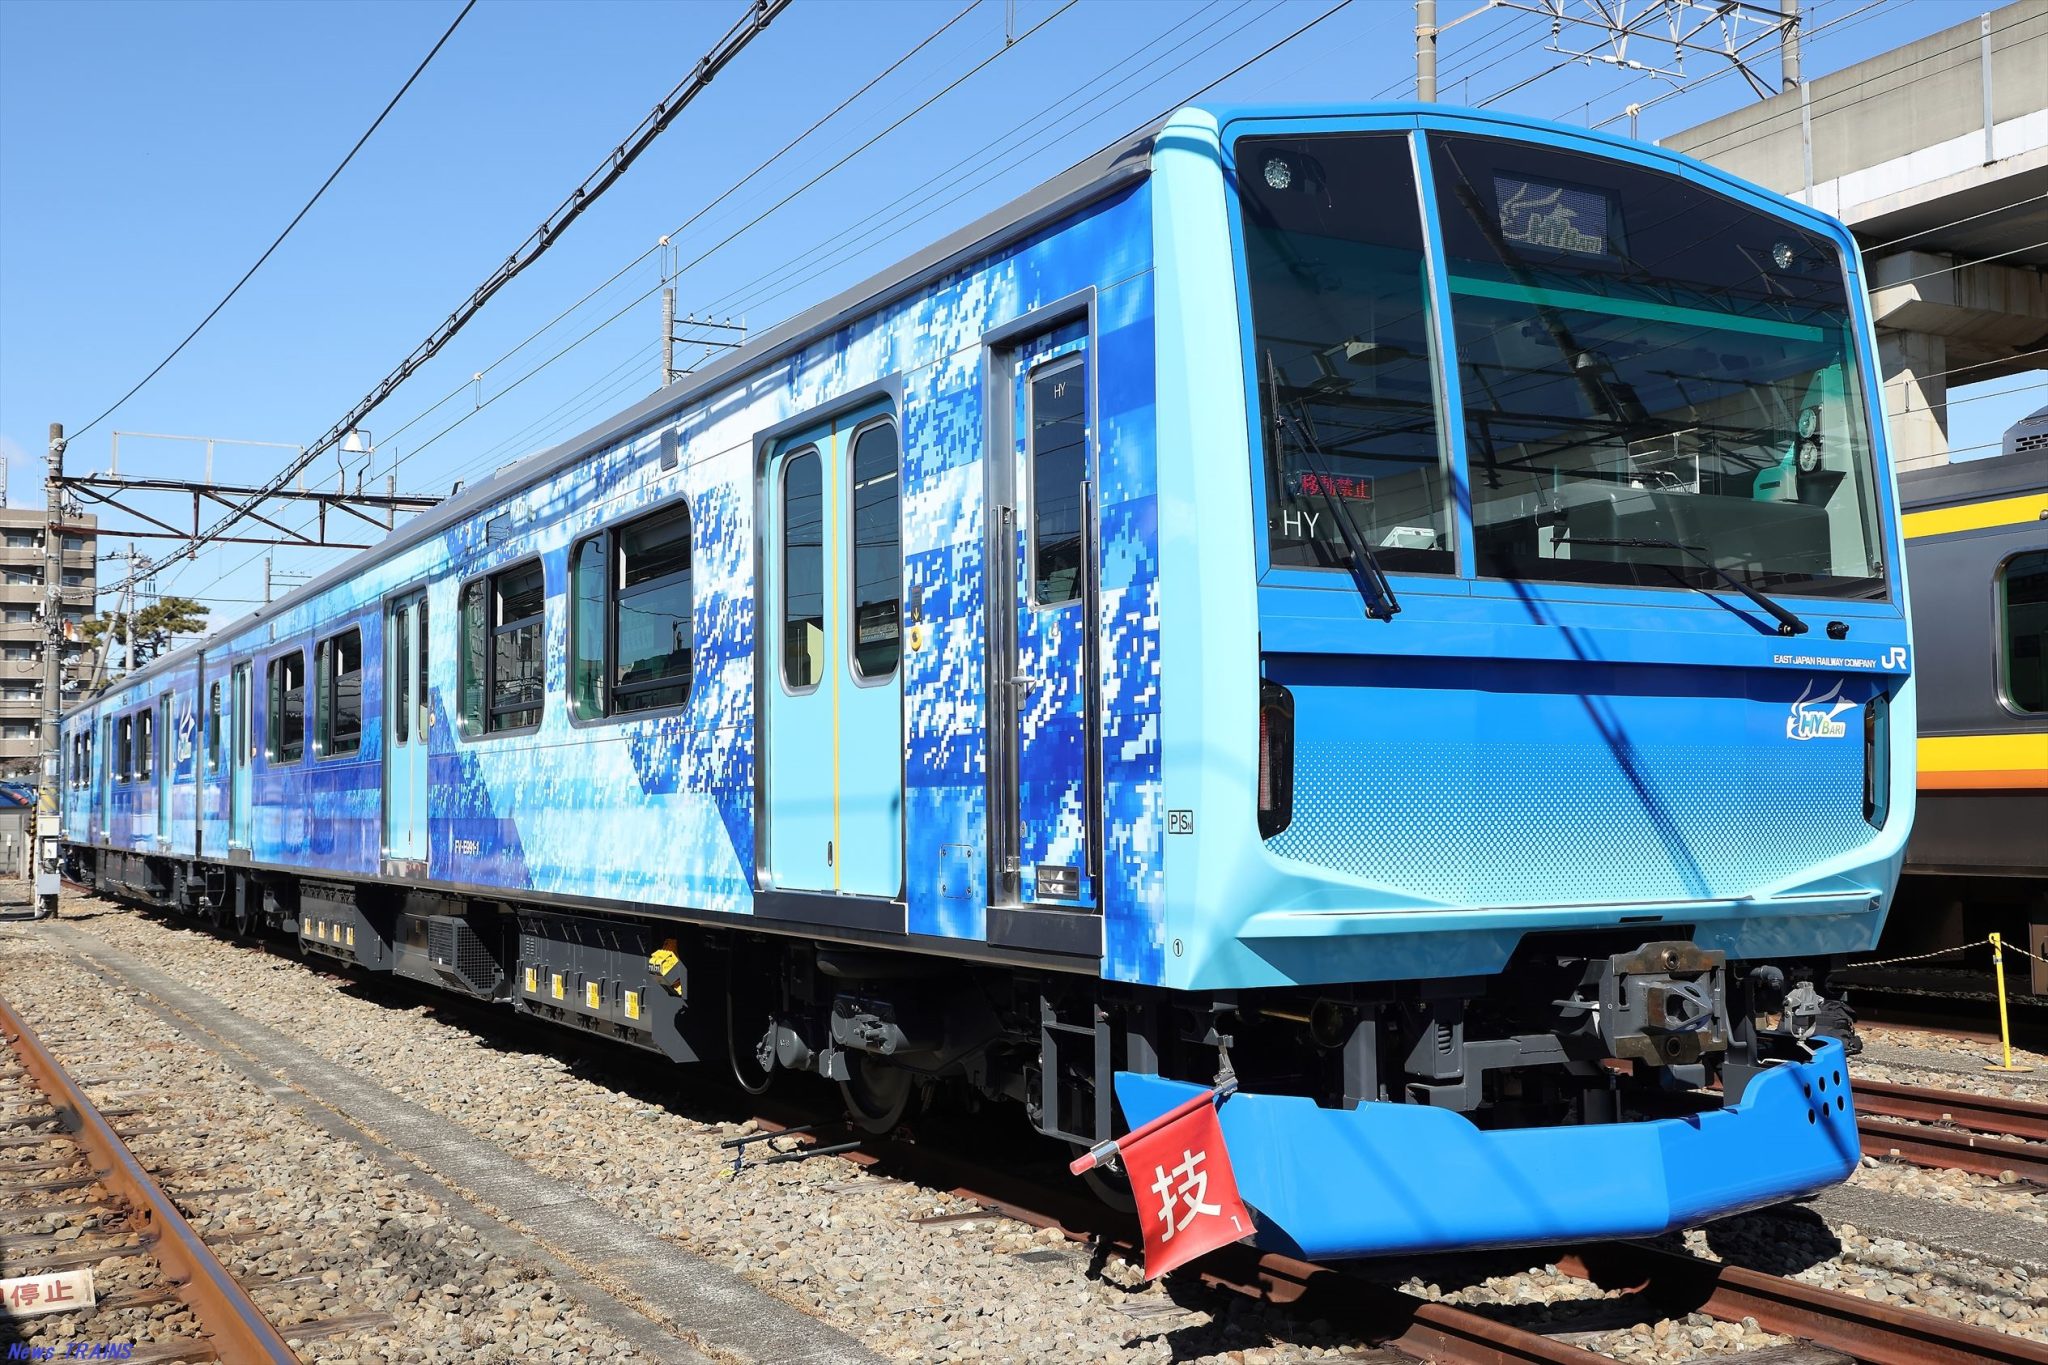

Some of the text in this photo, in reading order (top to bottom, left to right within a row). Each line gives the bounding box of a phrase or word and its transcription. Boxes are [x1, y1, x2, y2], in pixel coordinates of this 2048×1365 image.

[1054, 381, 1066, 399] HY
[1283, 509, 1320, 538] HY
[1774, 654, 1877, 668] EAST JAPAN RAILWAY COMPANY
[1881, 647, 1907, 669] JR
[1151, 1149, 1221, 1243] 技
[1230, 1215, 1243, 1233] 1
